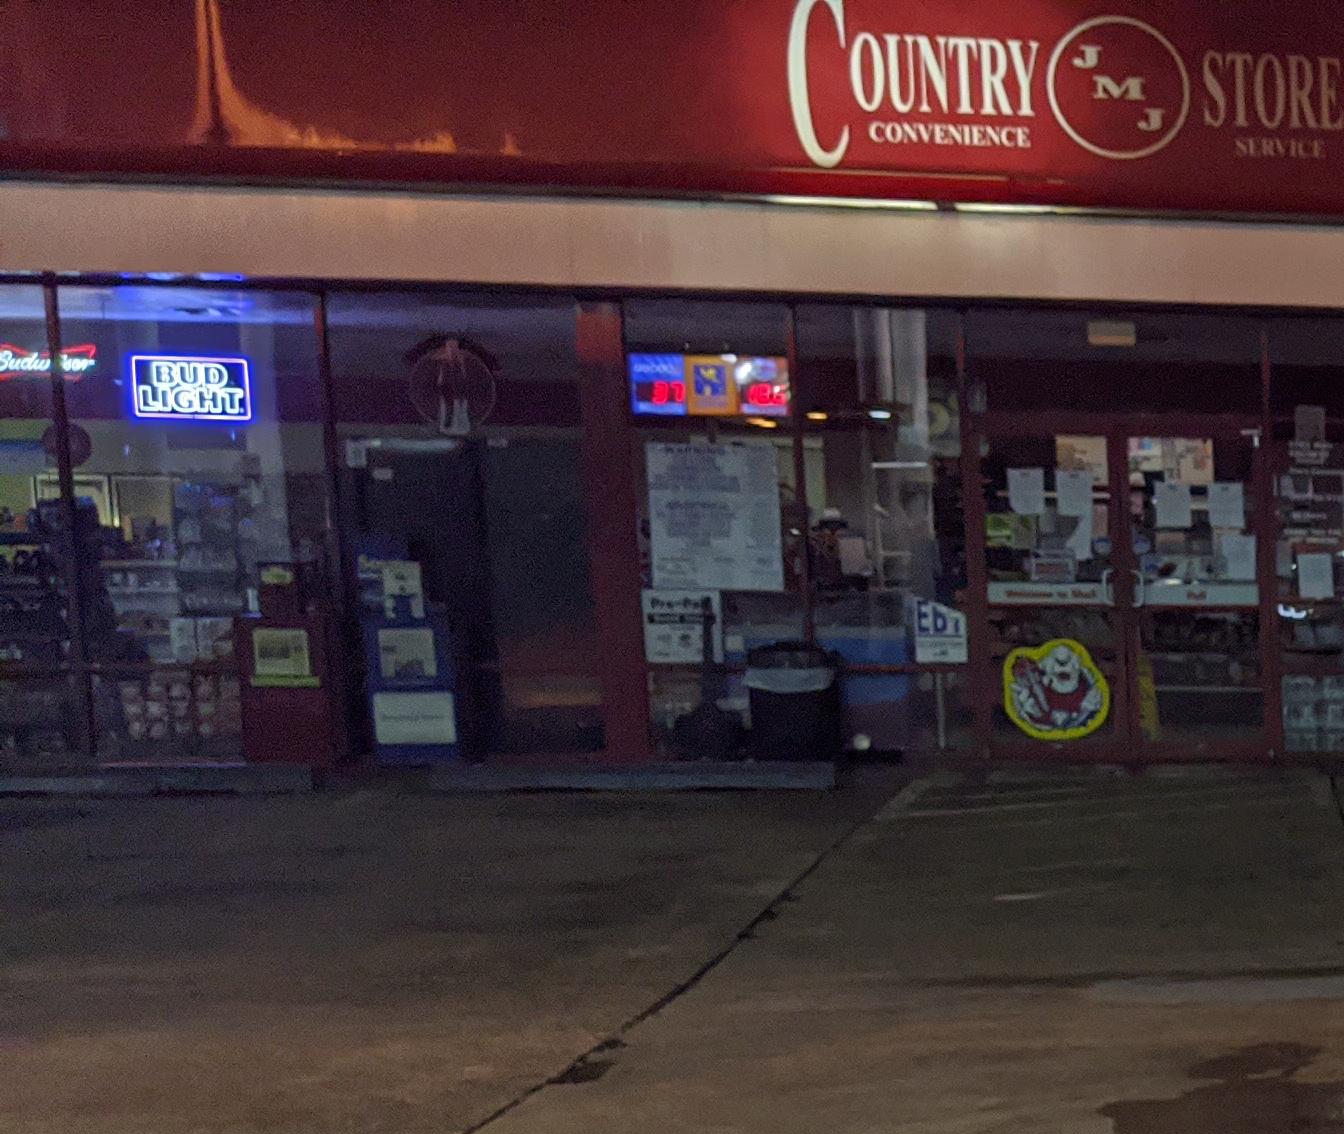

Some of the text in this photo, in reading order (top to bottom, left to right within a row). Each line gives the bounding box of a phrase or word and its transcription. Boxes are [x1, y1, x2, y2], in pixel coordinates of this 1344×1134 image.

[788, 0, 1040, 168] COUNTRY
[868, 121, 1032, 148] CONVENIENCE
[1234, 138, 1326, 159] SERVICE
[0, 350, 96, 373] Budwiser
[151, 361, 229, 388] BUD
[138, 385, 245, 415] LIGHT
